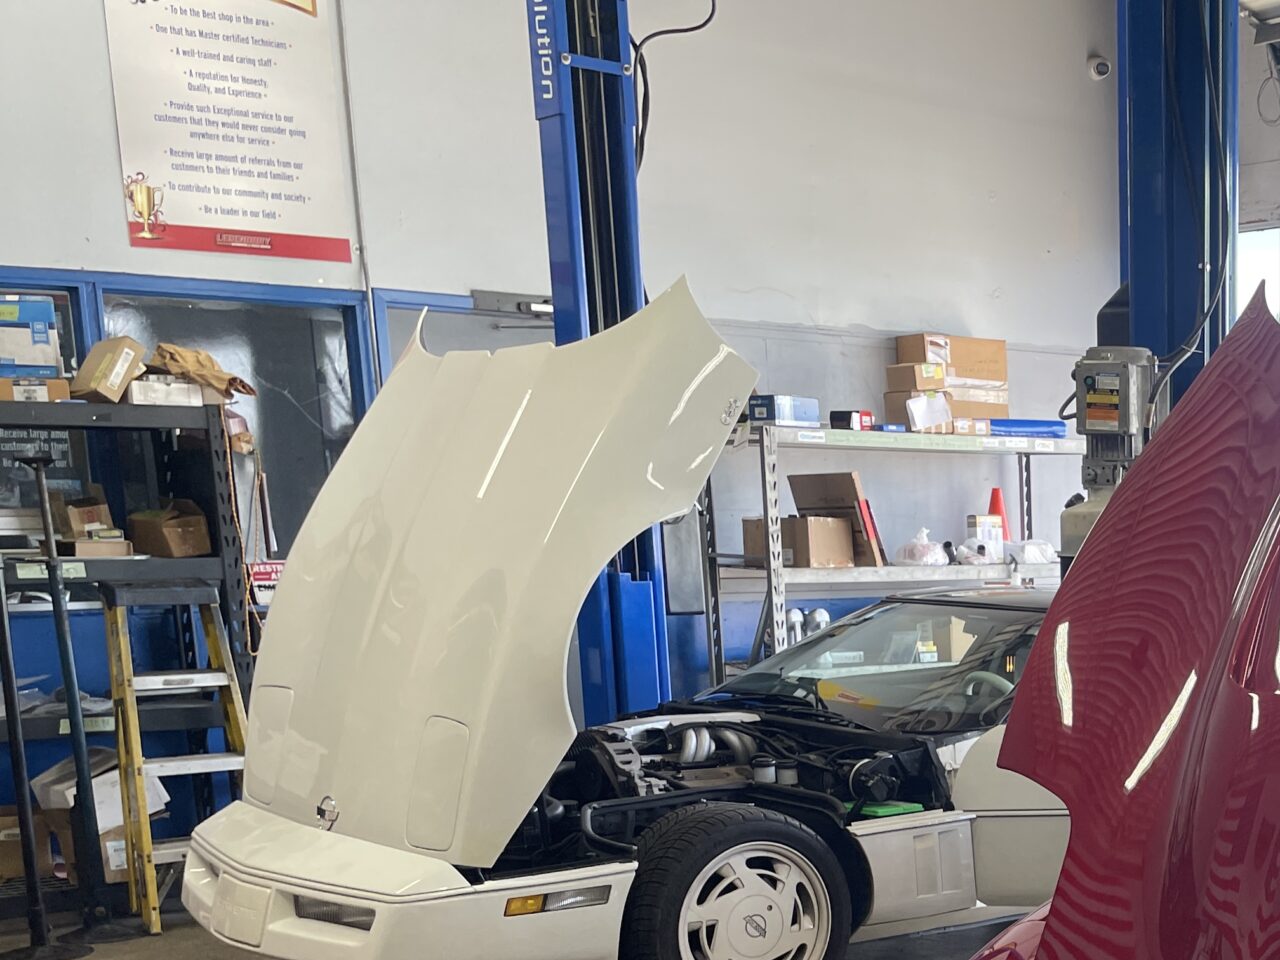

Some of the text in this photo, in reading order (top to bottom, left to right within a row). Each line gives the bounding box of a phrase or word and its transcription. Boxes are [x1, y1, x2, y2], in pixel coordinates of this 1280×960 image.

[171, 5, 269, 27] To be the Best shop in the area
[156, 24, 287, 50] One that has Master certified Technicians
[176, 47, 272, 67] A well-trained and caring staff
[534, 0, 553, 99] lution
[189, 69, 194, 78] A
[196, 71, 228, 82] reputation
[231, 74, 240, 83] for
[188, 82, 262, 99] Quality, and Experience
[170, 101, 194, 111] Provide
[196, 105, 211, 113] such
[213, 105, 249, 118] Exceptional
[251, 111, 273, 120] service
[275, 113, 282, 121] to
[154, 114, 306, 139] customers that they would never consider going
[190, 131, 269, 146] anywhere else for service
[170, 148, 303, 170] Receive large amount of referrals from our
[172, 163, 294, 182] customers to their friends and families
[168, 181, 305, 204] To contribute to our community and society
[204, 205, 212, 214] Be
[220, 206, 240, 216] leader
[242, 208, 248, 217] in
[250, 210, 259, 218] our
[262, 210, 276, 220] field
